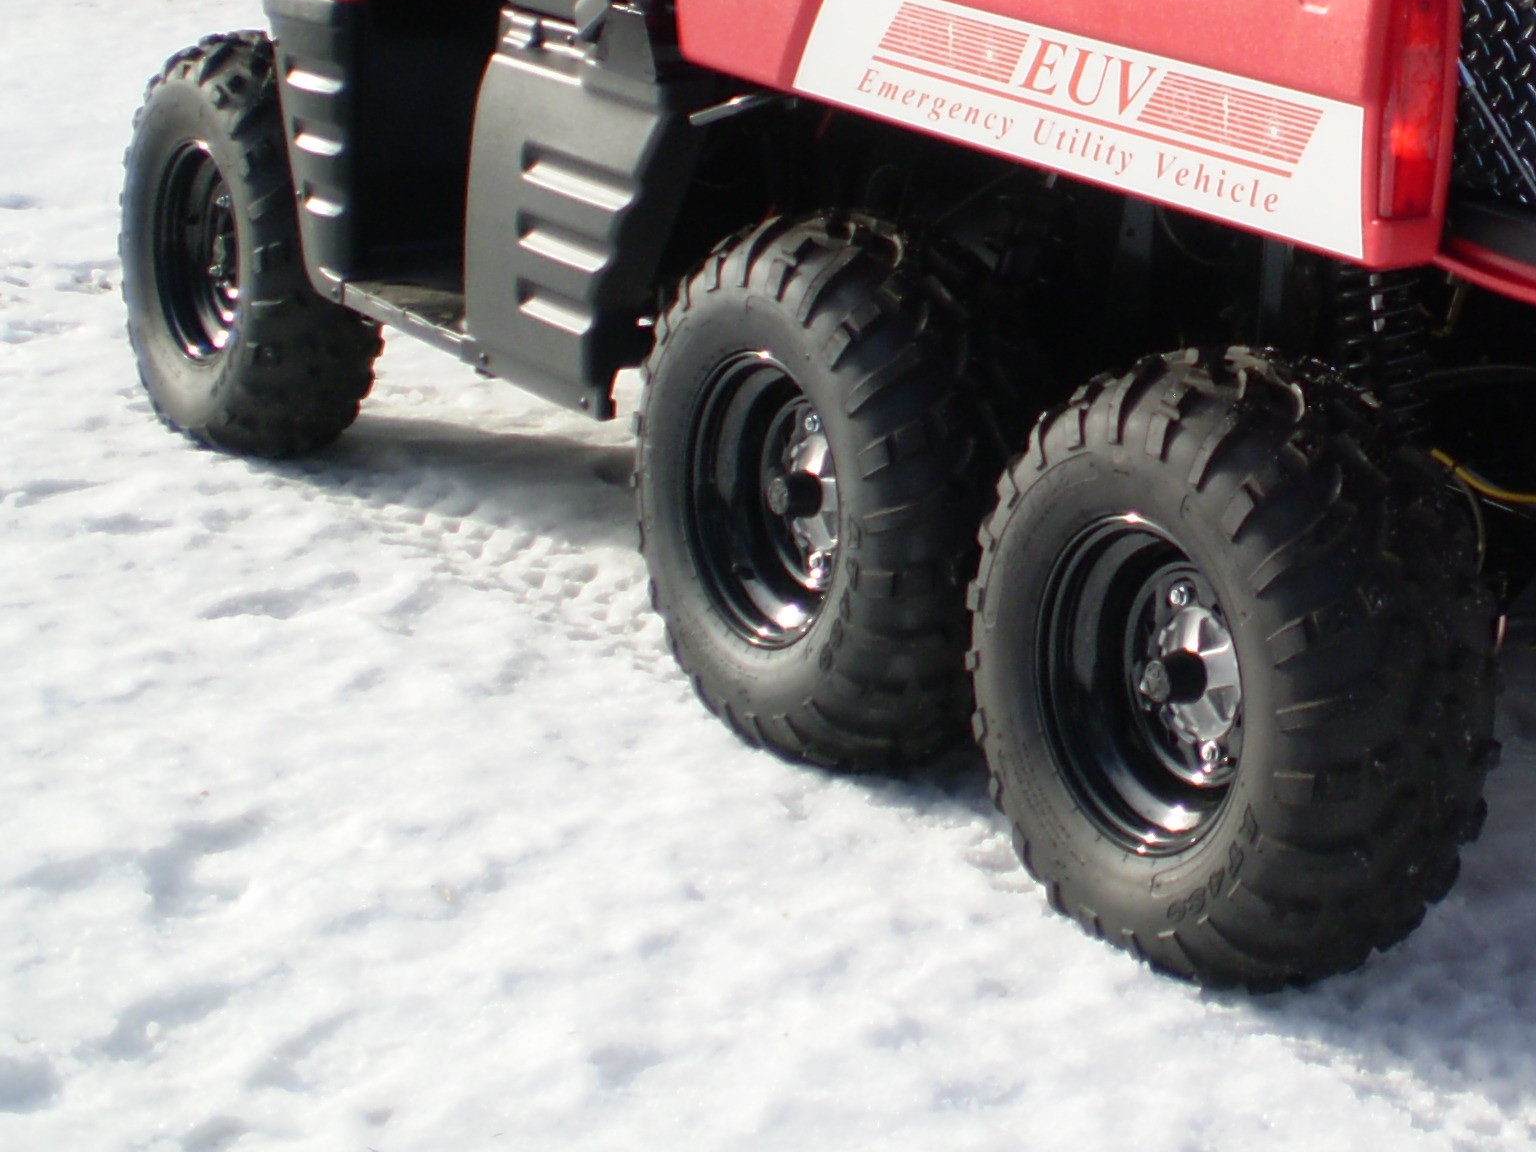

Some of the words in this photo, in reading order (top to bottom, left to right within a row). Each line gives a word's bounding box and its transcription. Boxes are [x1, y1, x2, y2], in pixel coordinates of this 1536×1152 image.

[1019, 38, 1158, 116] EUV
[857, 68, 1015, 140] Emergency
[1033, 118, 1133, 176] Utility
[1156, 152, 1279, 213] Vehicle
